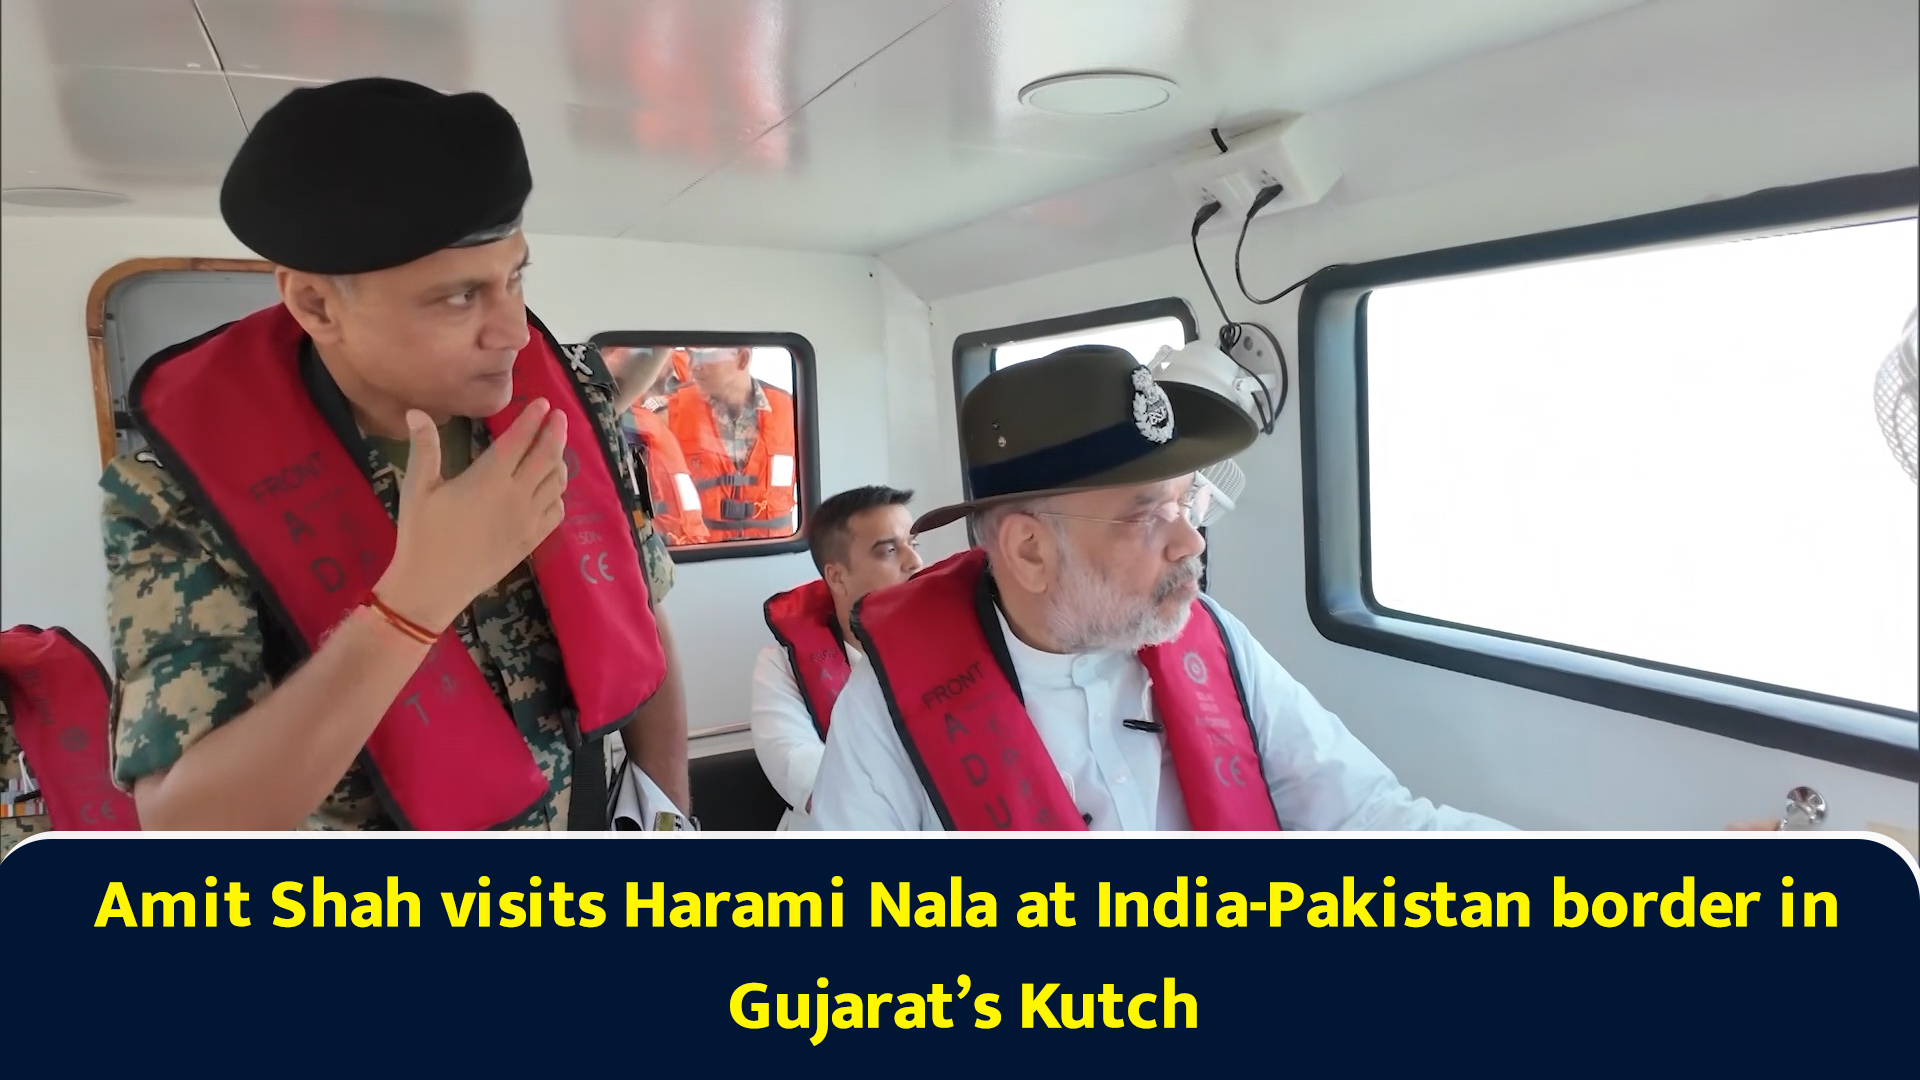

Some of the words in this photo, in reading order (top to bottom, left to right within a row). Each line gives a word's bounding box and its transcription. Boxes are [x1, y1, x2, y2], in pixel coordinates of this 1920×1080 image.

[249, 451, 329, 505] FRONT
[580, 551, 616, 586] CE
[921, 662, 985, 710] FRONT
[1214, 755, 1247, 789] CE
